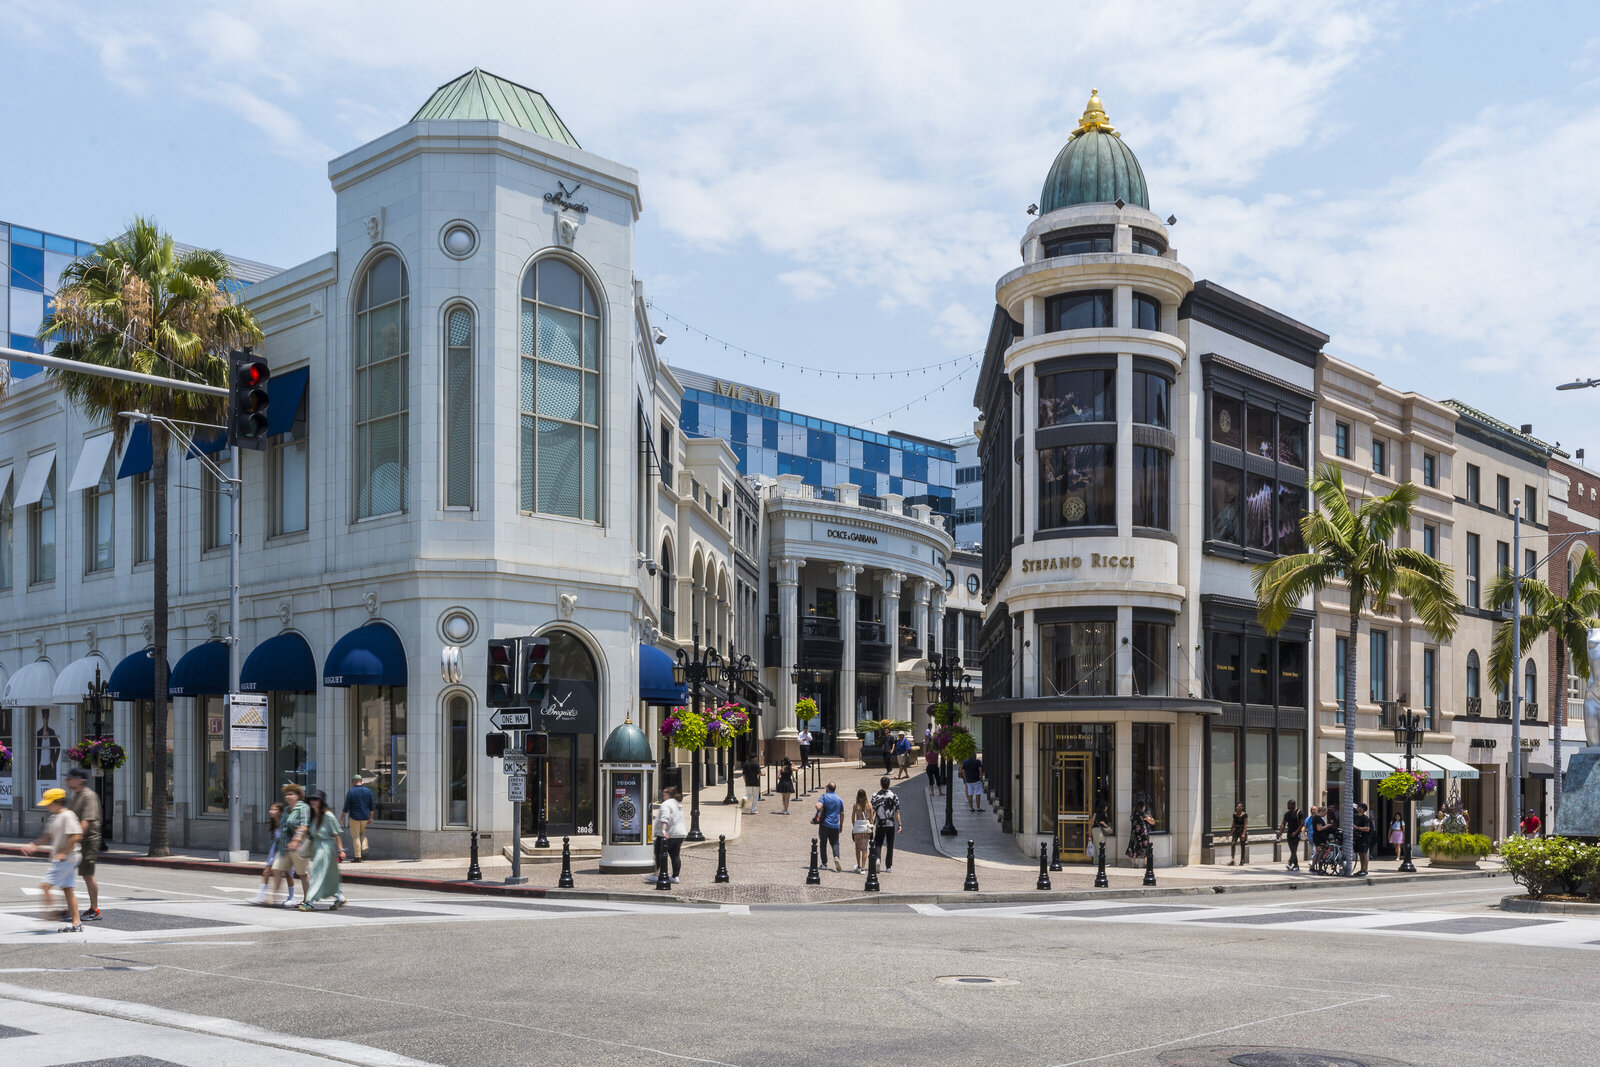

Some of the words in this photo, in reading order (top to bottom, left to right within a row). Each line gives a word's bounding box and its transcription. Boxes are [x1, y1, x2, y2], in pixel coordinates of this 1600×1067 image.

[716, 379, 777, 409] MGM
[1022, 556, 1082, 573] STEFANO
[1091, 552, 1135, 569] RICCI
[501, 715, 513, 724] ONE
[515, 714, 526, 723] WAY
[504, 763, 513, 772] OK
